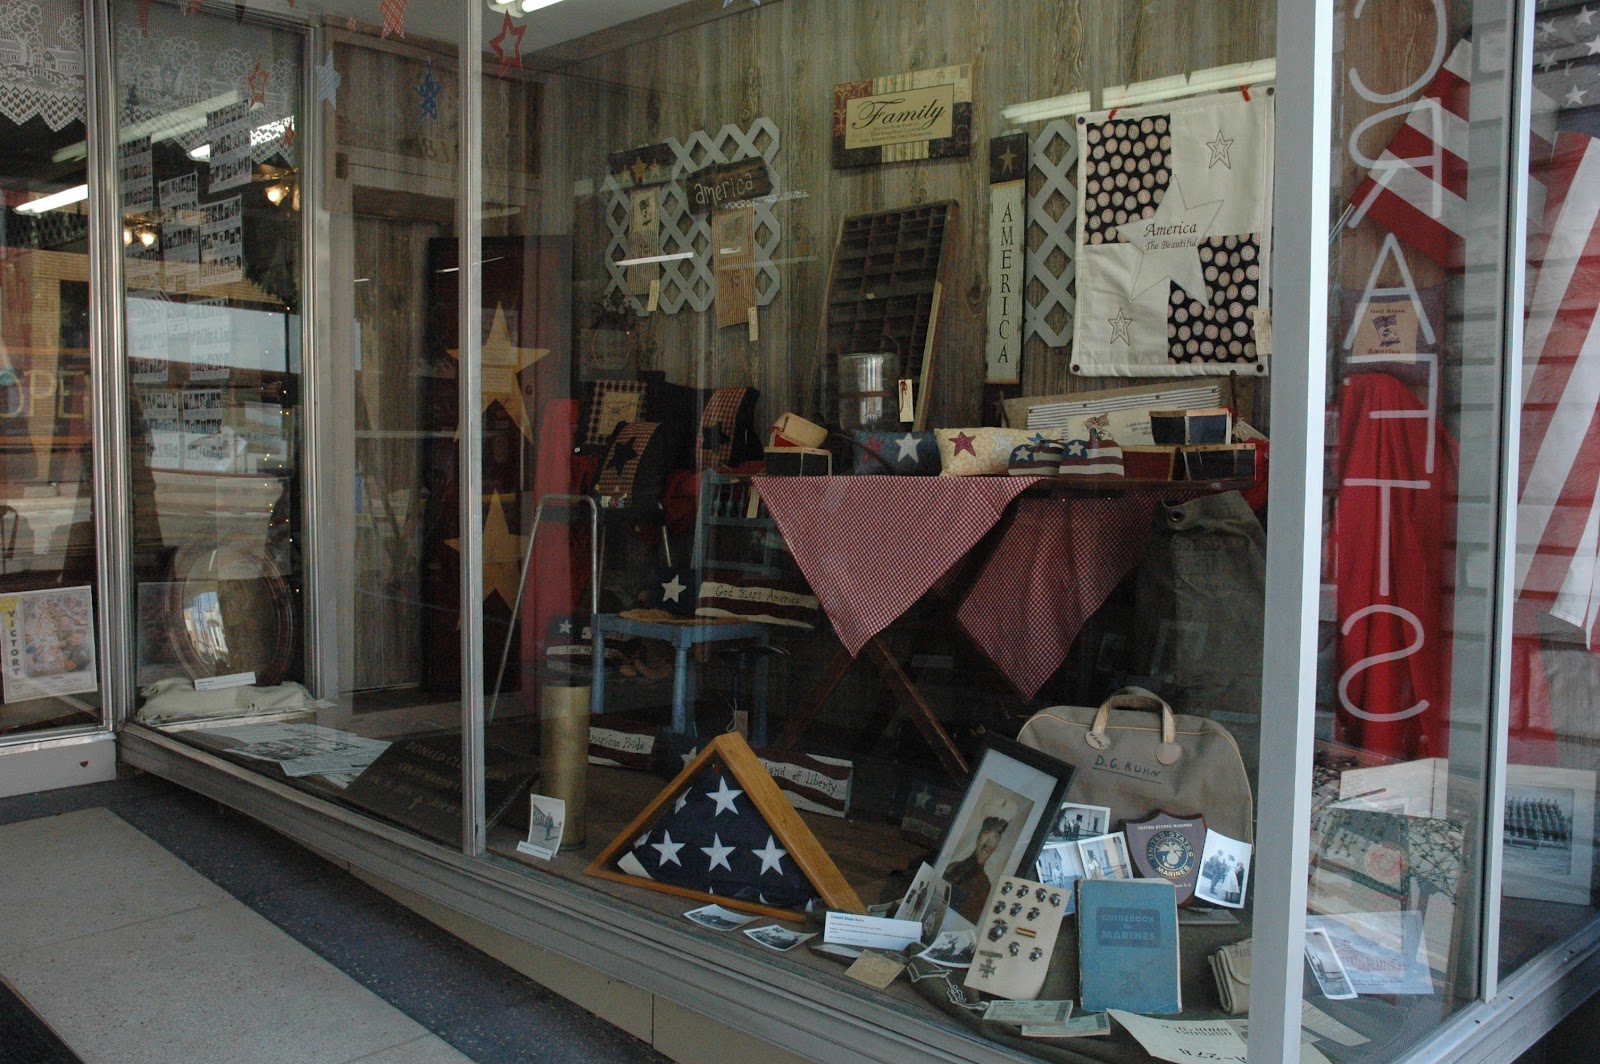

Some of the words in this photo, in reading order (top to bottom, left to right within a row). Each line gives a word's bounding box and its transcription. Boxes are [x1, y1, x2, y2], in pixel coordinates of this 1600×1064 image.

[852, 98, 947, 130] Family
[694, 173, 753, 206] america
[1143, 220, 1197, 237] America
[1145, 240, 1159, 251] The
[1160, 237, 1198, 250] Beautiful
[998, 202, 1014, 363] AMERICA
[715, 584, 734, 597] God
[8, 610, 20, 675] VICTORY
[589, 734, 621, 748] merican
[1124, 761, 1161, 777] KUHN
[1147, 832, 1165, 860] UNITED
[1168, 831, 1194, 857] STATES
[1156, 865, 1190, 877] MARINES
[1101, 930, 1155, 941] MARINES
